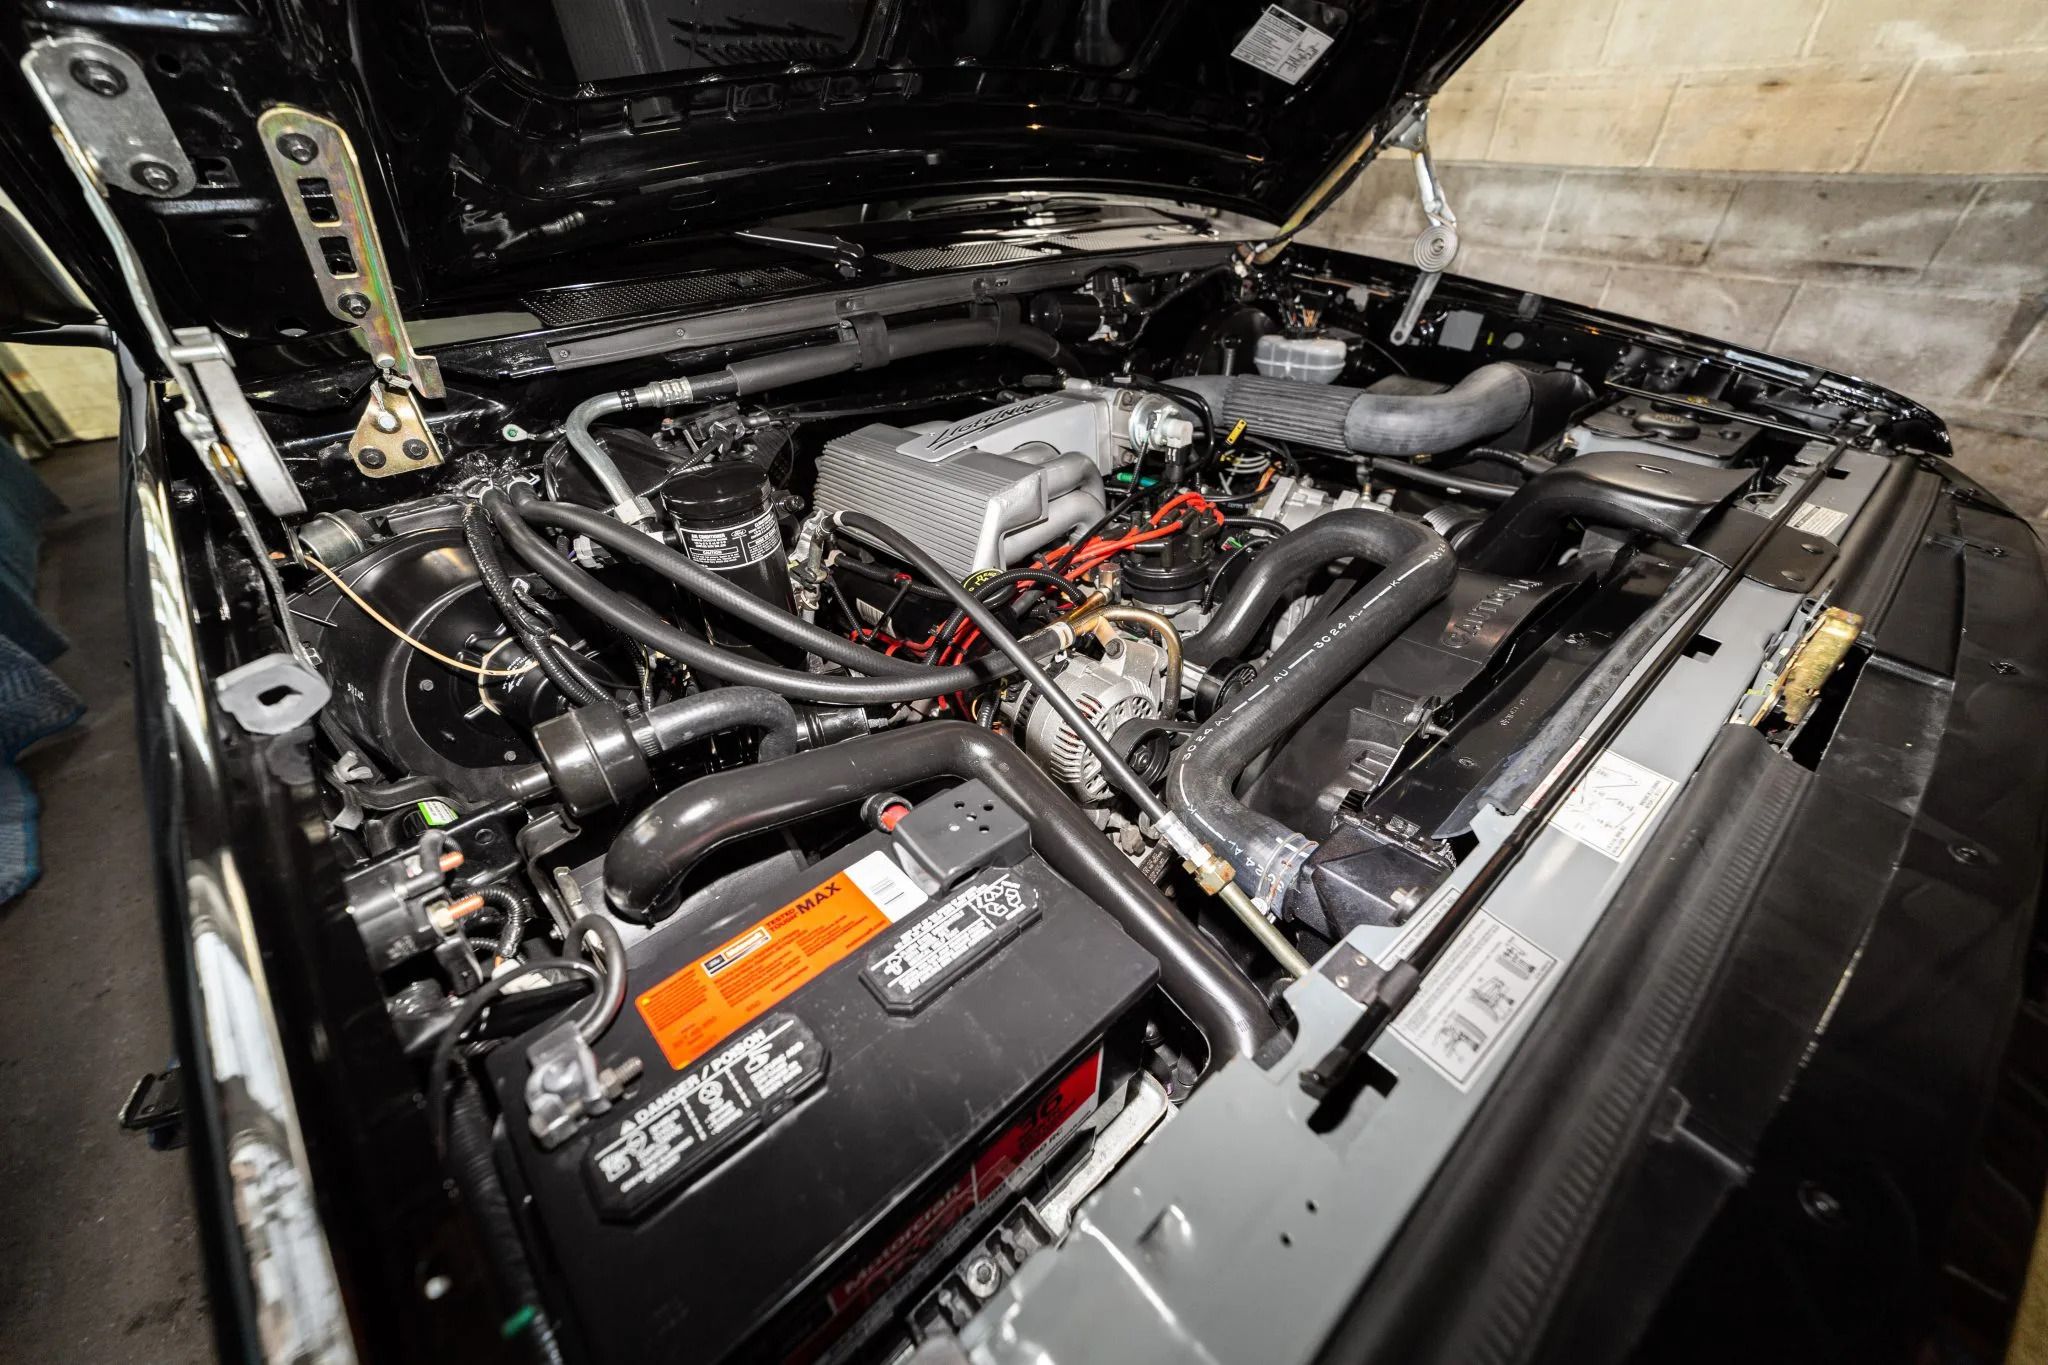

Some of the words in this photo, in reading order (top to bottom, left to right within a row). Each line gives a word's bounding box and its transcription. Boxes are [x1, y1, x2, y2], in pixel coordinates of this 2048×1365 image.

[926, 399, 1057, 450] LIGHTNING
[796, 881, 842, 915] MAX
[634, 1076, 701, 1124] DANGER
[708, 1027, 767, 1072] POISON
